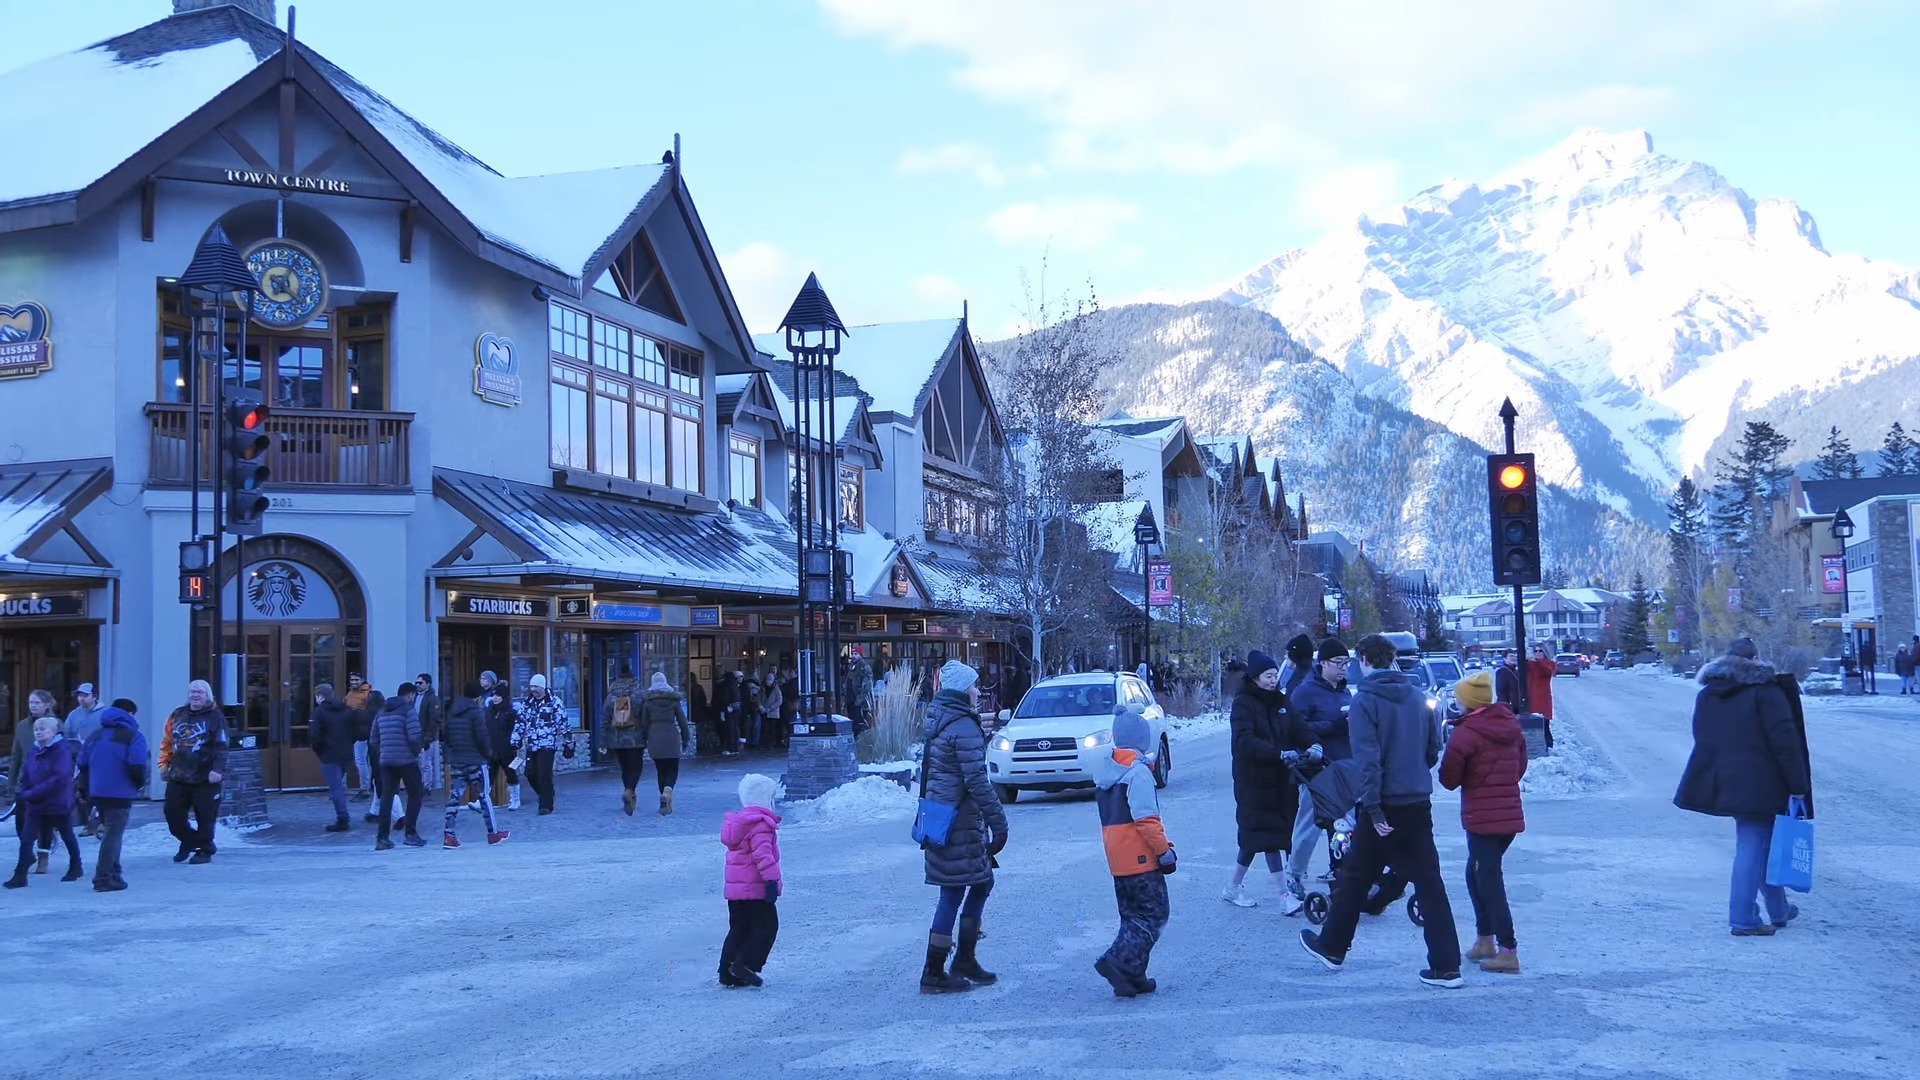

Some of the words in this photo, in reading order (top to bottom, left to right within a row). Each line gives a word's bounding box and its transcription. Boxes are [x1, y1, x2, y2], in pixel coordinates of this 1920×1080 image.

[224, 169, 277, 184] TOWN
[282, 175, 349, 192] CENTRE
[273, 249, 288, 260] 12
[0, 344, 38, 355] LISSA'S
[189, 577, 201, 597] 14
[469, 598, 533, 615] STARBUCKS
